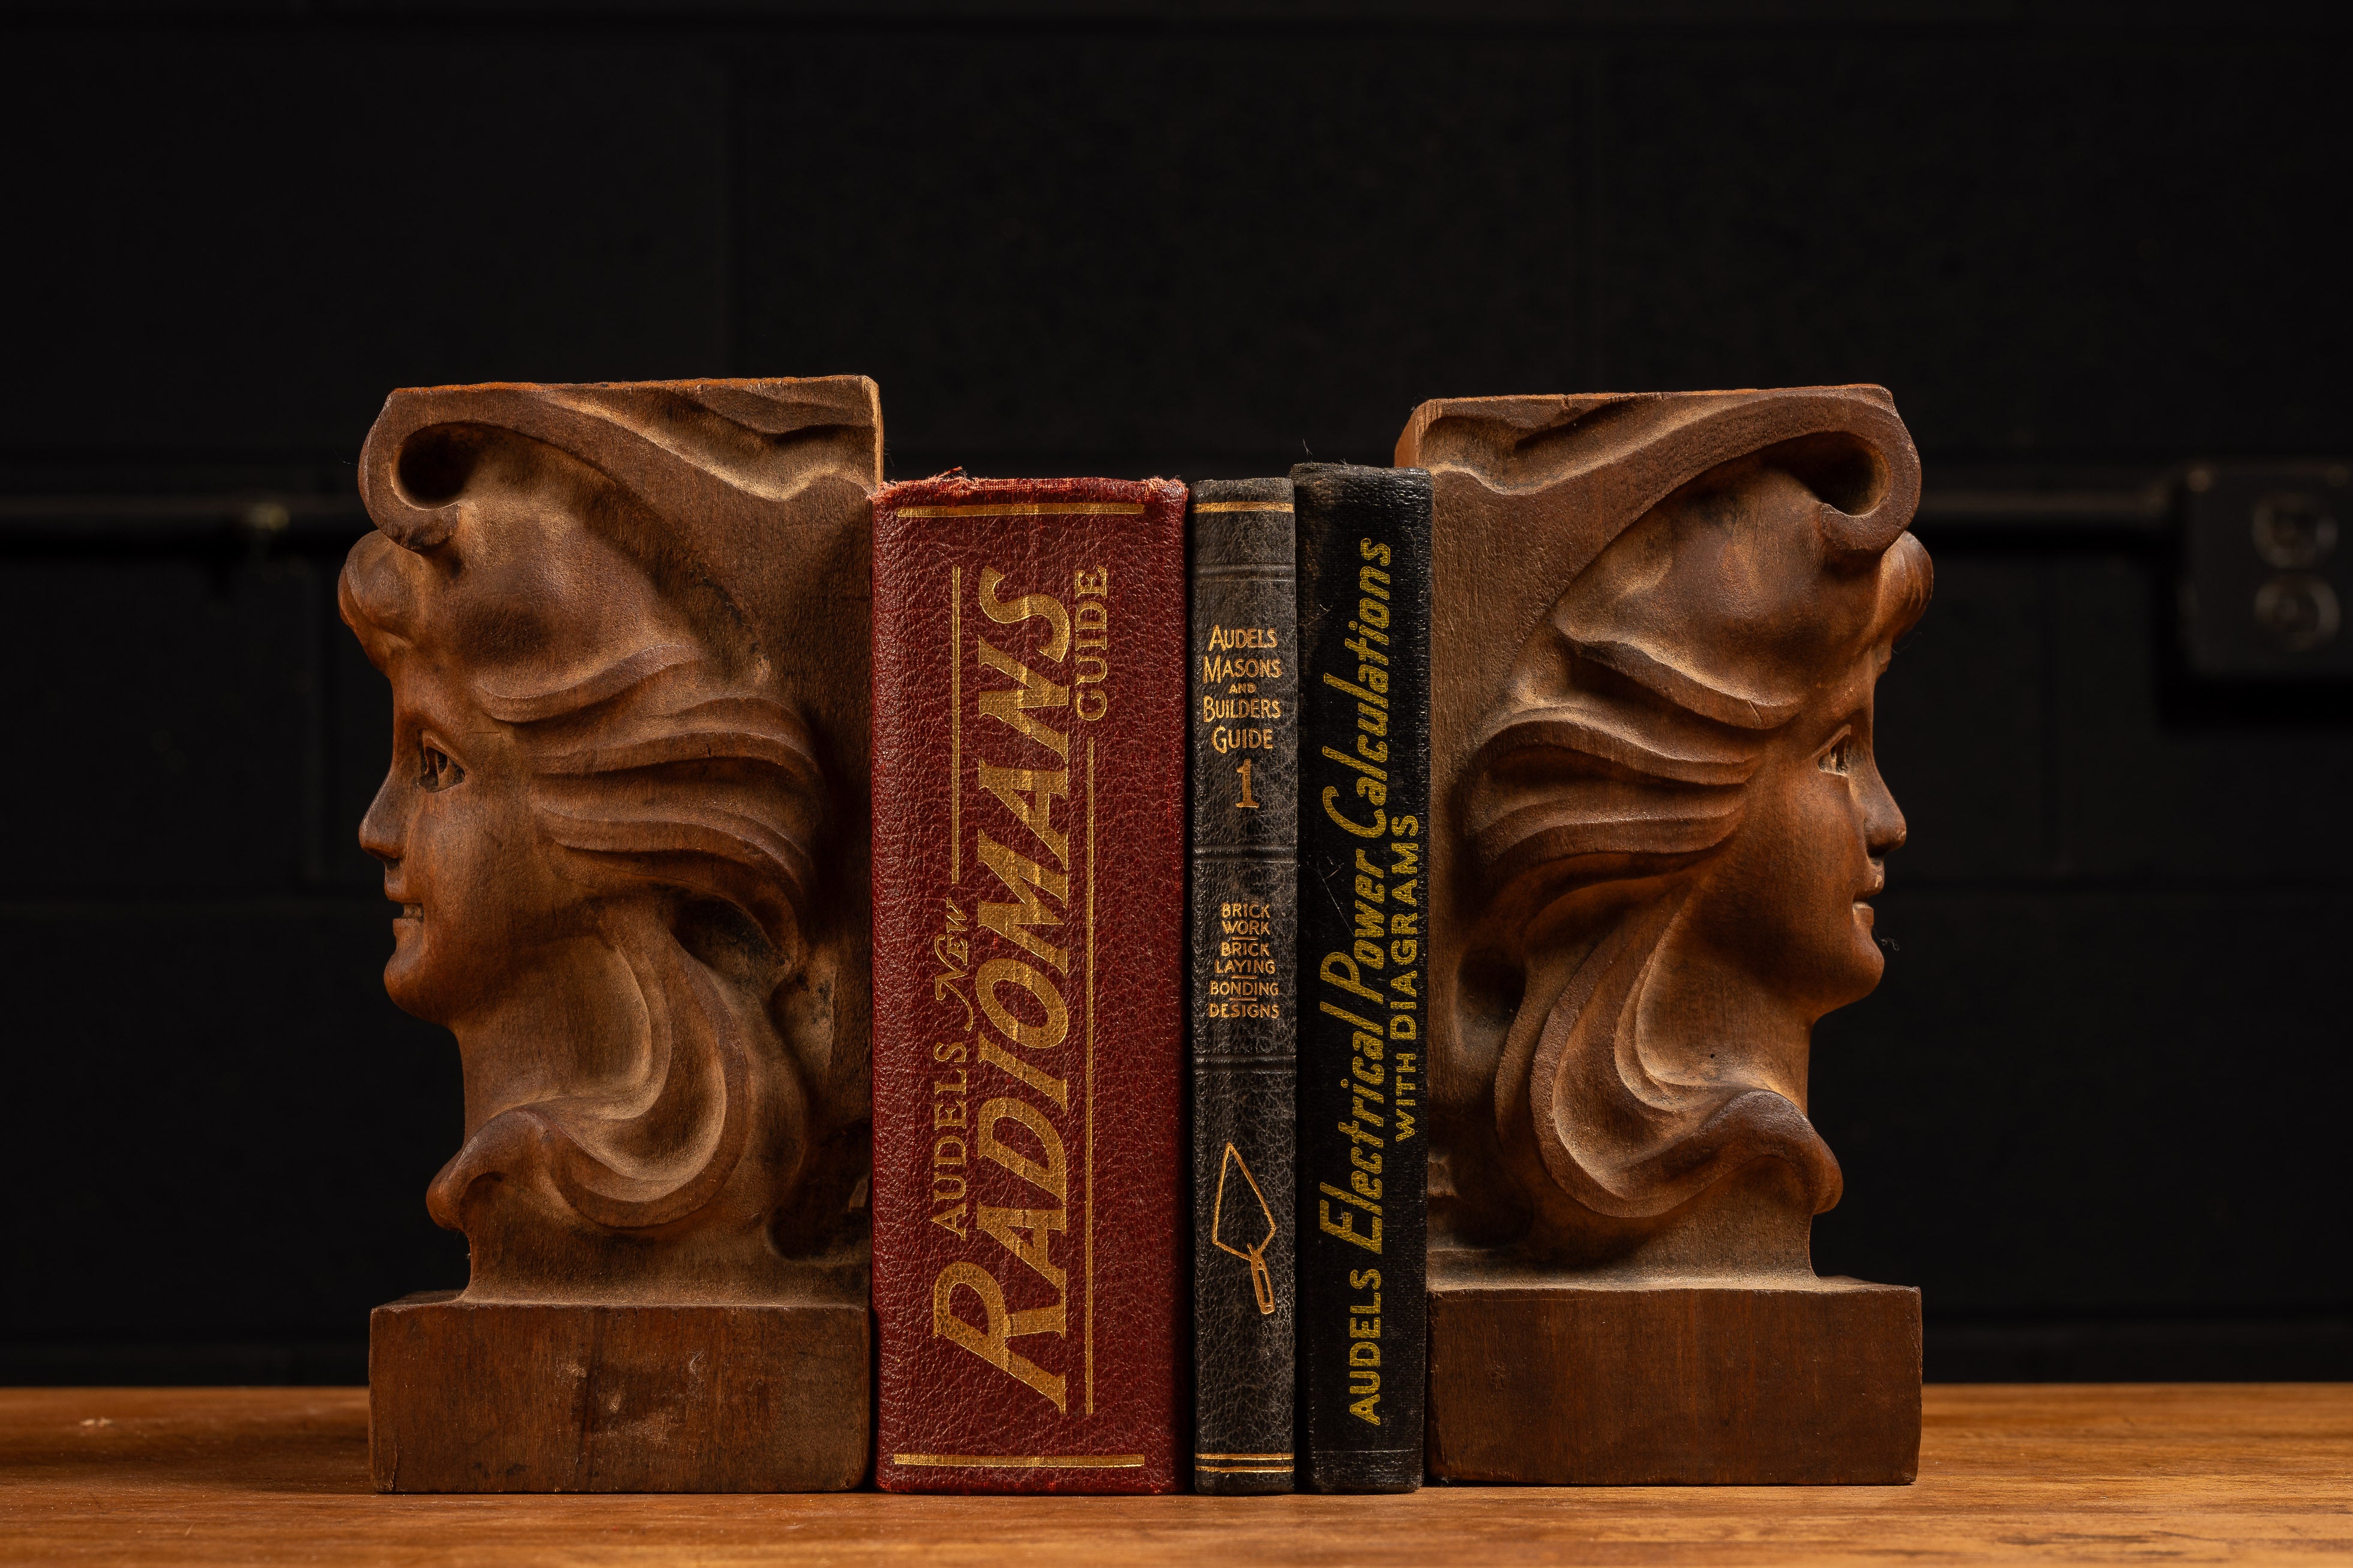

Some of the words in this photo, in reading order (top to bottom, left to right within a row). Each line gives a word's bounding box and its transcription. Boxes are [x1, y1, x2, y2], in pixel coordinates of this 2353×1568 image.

[1074, 565, 1109, 721] GUIDE
[1208, 625, 1278, 652] AUDELS
[1202, 655, 1282, 683] MASONS
[1228, 682, 1257, 694] AND
[1322, 538, 1390, 838] Calculations
[1211, 725, 1274, 754] GUIDE
[1236, 758, 1259, 808] 1
[1222, 902, 1271, 918] BRICK
[1222, 920, 1271, 936] WORK
[1320, 848, 1384, 1004] Power
[1390, 815, 1419, 1040] DIAGRAMS
[1214, 960, 1276, 974] LAYING
[1220, 942, 1270, 957] BRICK
[932, 565, 1070, 1414] RADIOMANS
[1210, 981, 1279, 996] BONDING
[1208, 1003, 1280, 1019] DESIGNS
[1396, 1053, 1417, 1141] WITH
[931, 1041, 967, 1241] AUDELS
[1320, 1002, 1384, 1254] Electrical
[1349, 1269, 1381, 1426] AUDELS
